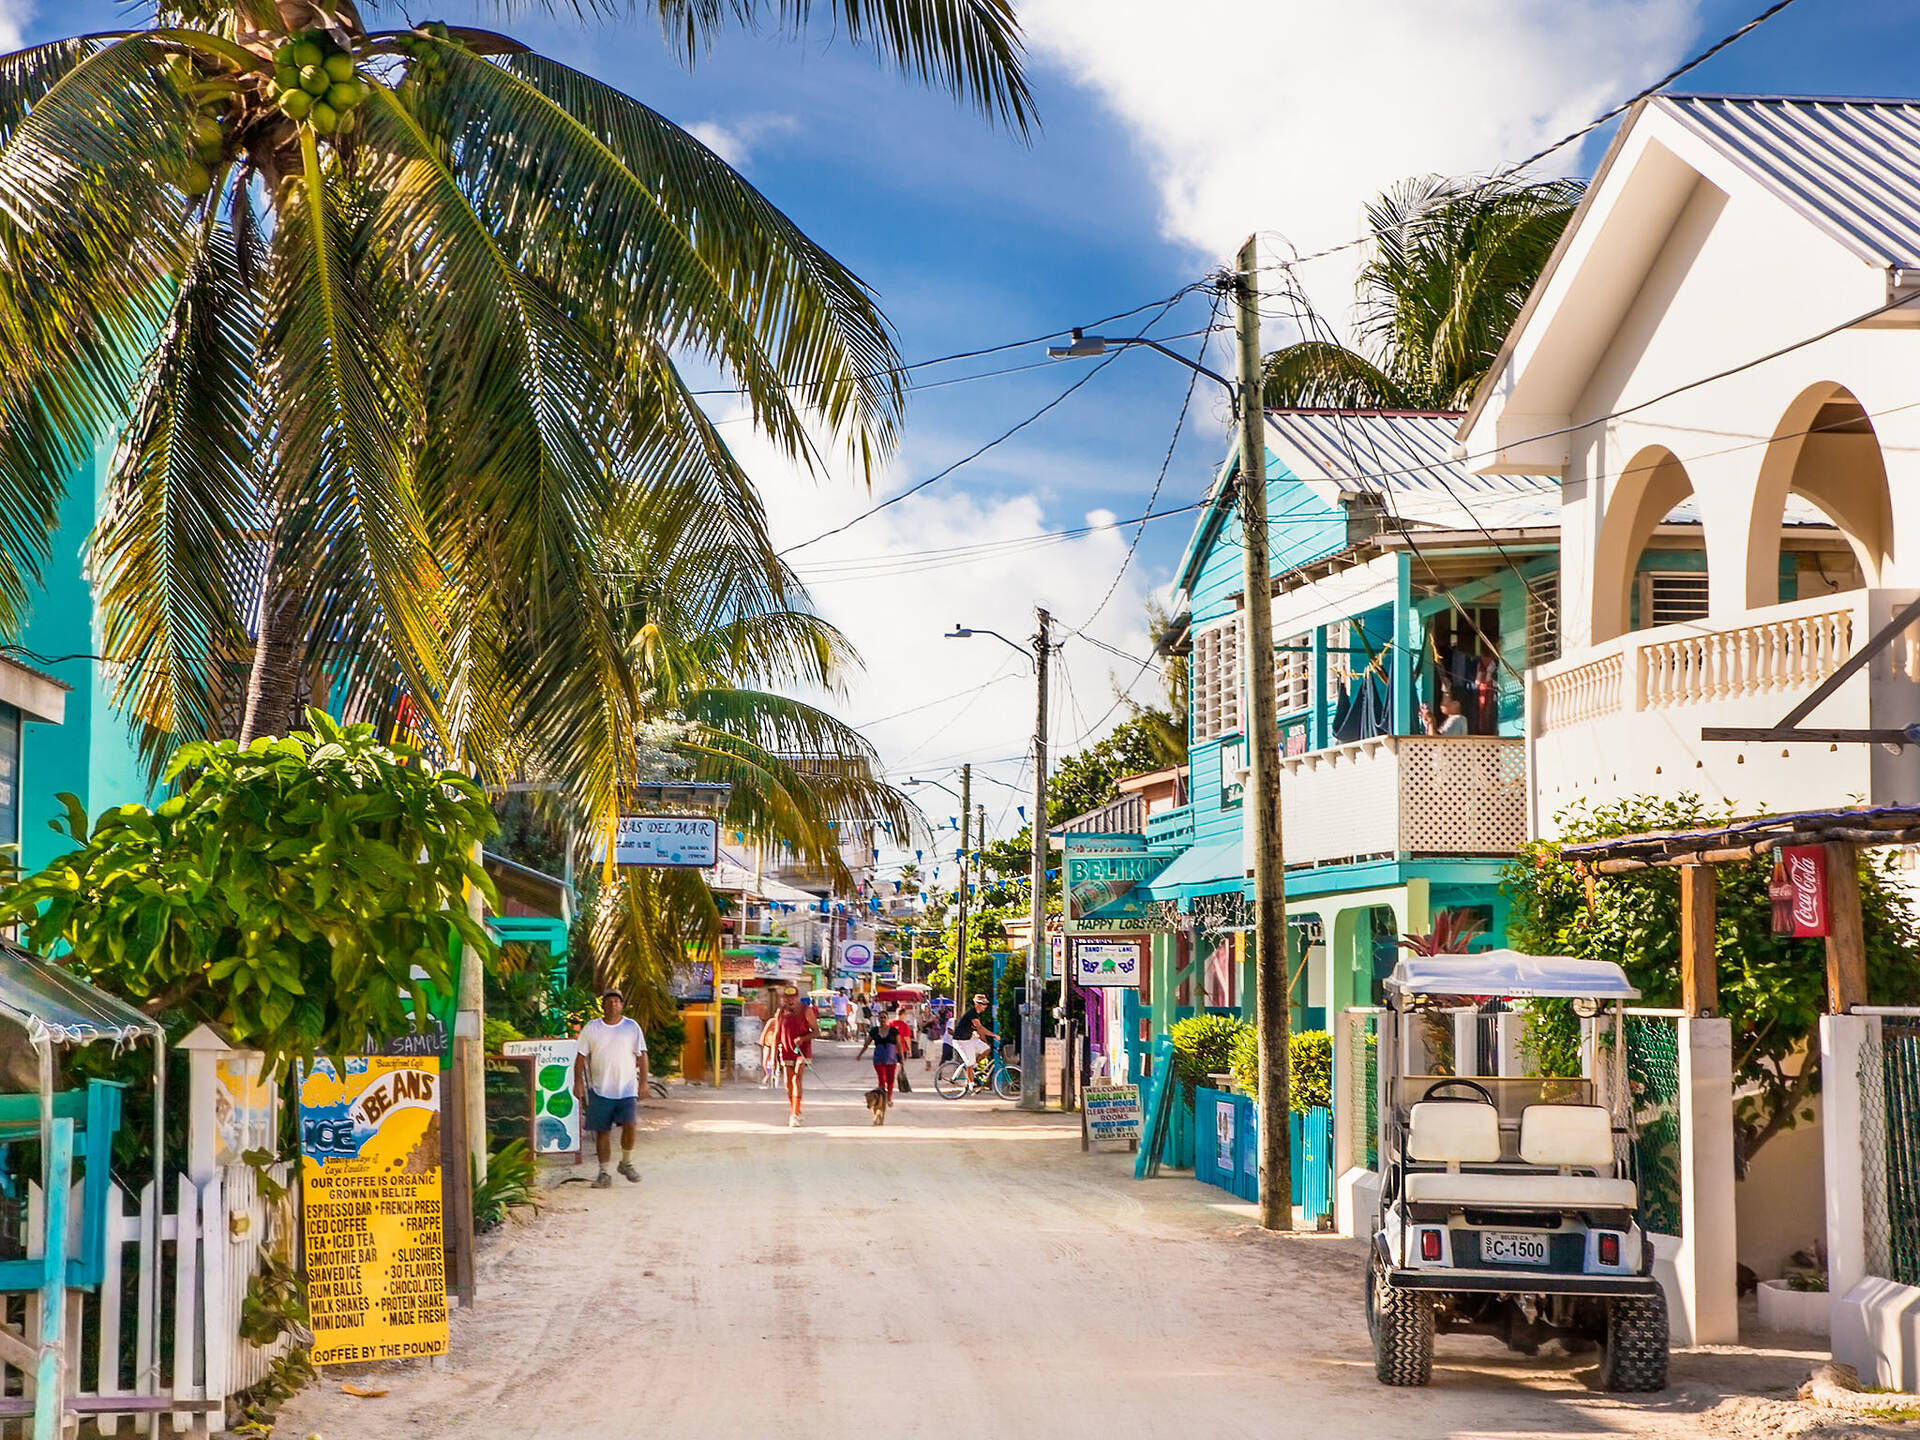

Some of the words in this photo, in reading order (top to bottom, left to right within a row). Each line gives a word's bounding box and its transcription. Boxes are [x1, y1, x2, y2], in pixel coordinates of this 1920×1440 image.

[647, 822, 671, 834] DEL
[674, 822, 711, 837] MAR
[1791, 853, 1819, 928] Coca-Cola
[1077, 919, 1114, 931] HAPPY
[303, 1119, 356, 1154] ICE
[361, 1071, 435, 1125] BEANS
[1100, 1113, 1129, 1121] ROOMS
[311, 1178, 333, 1188] OUR
[335, 1176, 376, 1187] COFFEE
[378, 1175, 388, 1186] IS
[390, 1175, 435, 1186] ORGANIC
[329, 1188, 366, 1200] GROWN
[369, 1188, 379, 1199] IN
[382, 1187, 417, 1198] BELIZE
[306, 1202, 354, 1219] ESPRESSO
[356, 1201, 372, 1216] BAR
[380, 1200, 413, 1215] FRENCH
[414, 1200, 440, 1214] PRESS
[307, 1221, 329, 1235] ICED
[330, 1218, 367, 1234] COFFEE
[406, 1216, 440, 1231] FRAPPE
[307, 1235, 326, 1250] TEA
[333, 1234, 354, 1249] ICED
[357, 1232, 375, 1247] TEA
[419, 1232, 441, 1246] CHAI
[1494, 1241, 1544, 1257] C-1500
[308, 1250, 356, 1267] SMOOTHIE
[359, 1248, 377, 1263] BAR
[398, 1247, 442, 1262] SLUSHIES
[309, 1266, 345, 1283] SHAVED
[346, 1265, 361, 1280] ICE
[390, 1265, 401, 1279] 30
[404, 1262, 443, 1278] FLAVORS
[310, 1283, 331, 1299] RUM
[333, 1281, 362, 1297] BALLS
[390, 1278, 443, 1295] CHOCOLATES
[311, 1299, 334, 1315] MILK
[336, 1297, 369, 1312] SHAKES
[381, 1295, 416, 1311] PROTEIN
[418, 1293, 444, 1309] SHAKE
[312, 1315, 334, 1331] MINI
[335, 1313, 365, 1329] DONUT
[389, 1311, 414, 1327] MADE
[418, 1308, 446, 1324] FRESH
[314, 1347, 359, 1363] COFFEE
[361, 1345, 377, 1359] BY
[380, 1344, 401, 1356] THE
